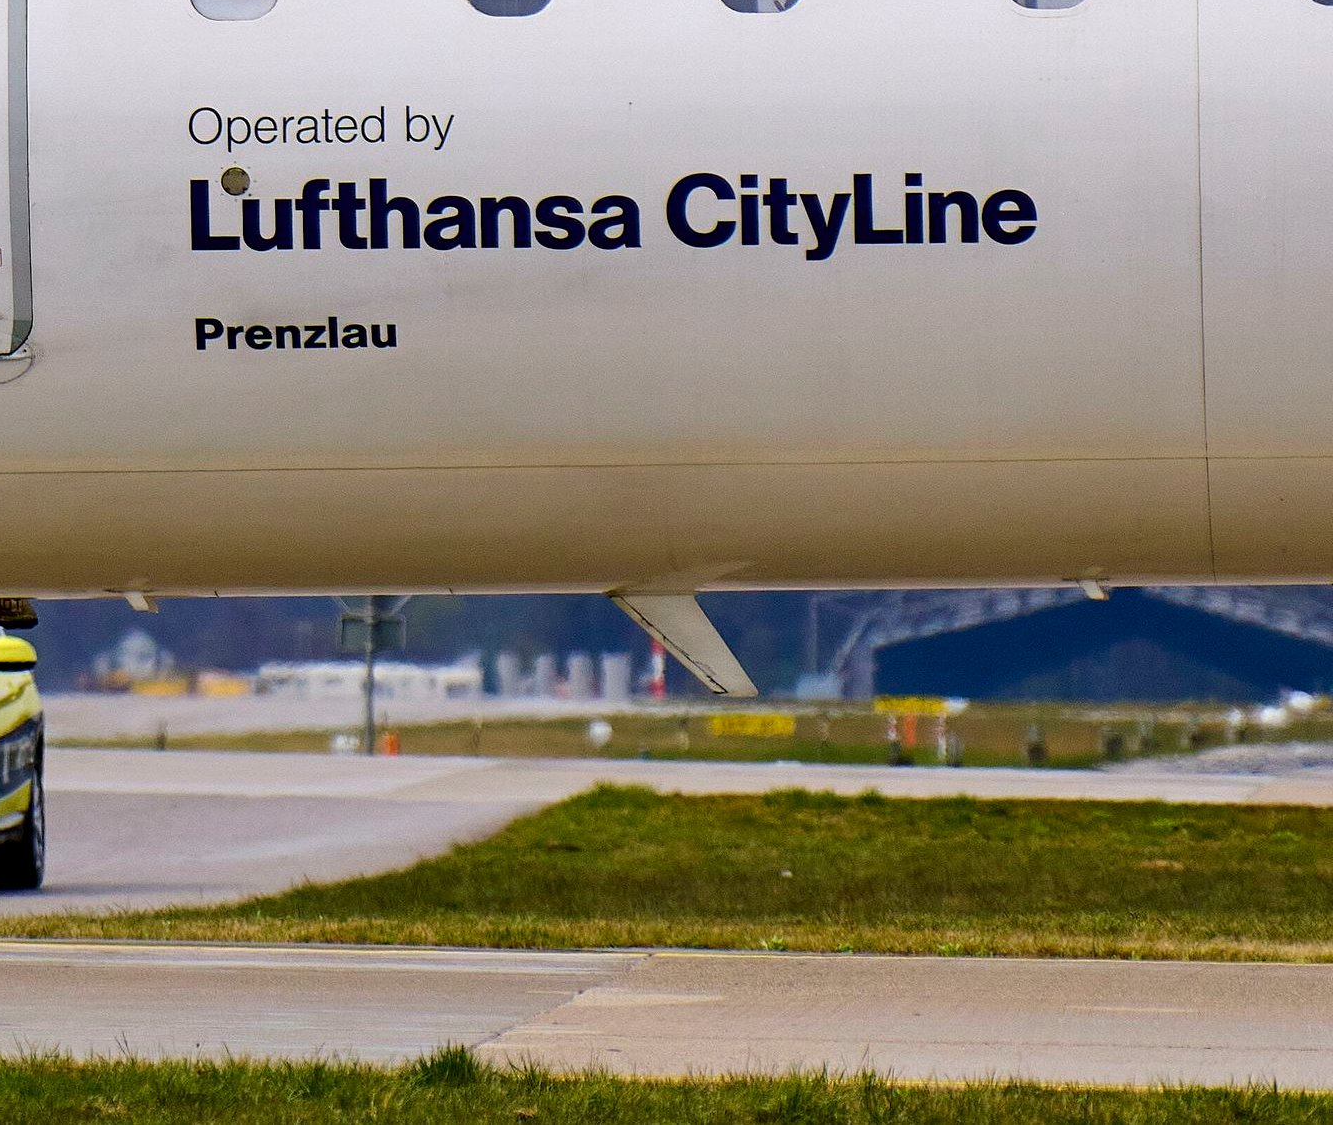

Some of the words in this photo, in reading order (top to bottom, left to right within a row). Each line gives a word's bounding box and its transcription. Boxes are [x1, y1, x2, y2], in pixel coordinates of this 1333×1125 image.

[188, 105, 385, 153] Operated
[405, 105, 455, 151] by
[189, 177, 642, 252] Lufthansa
[666, 172, 1038, 261] CityLine
[195, 316, 397, 351] Prenzlau
